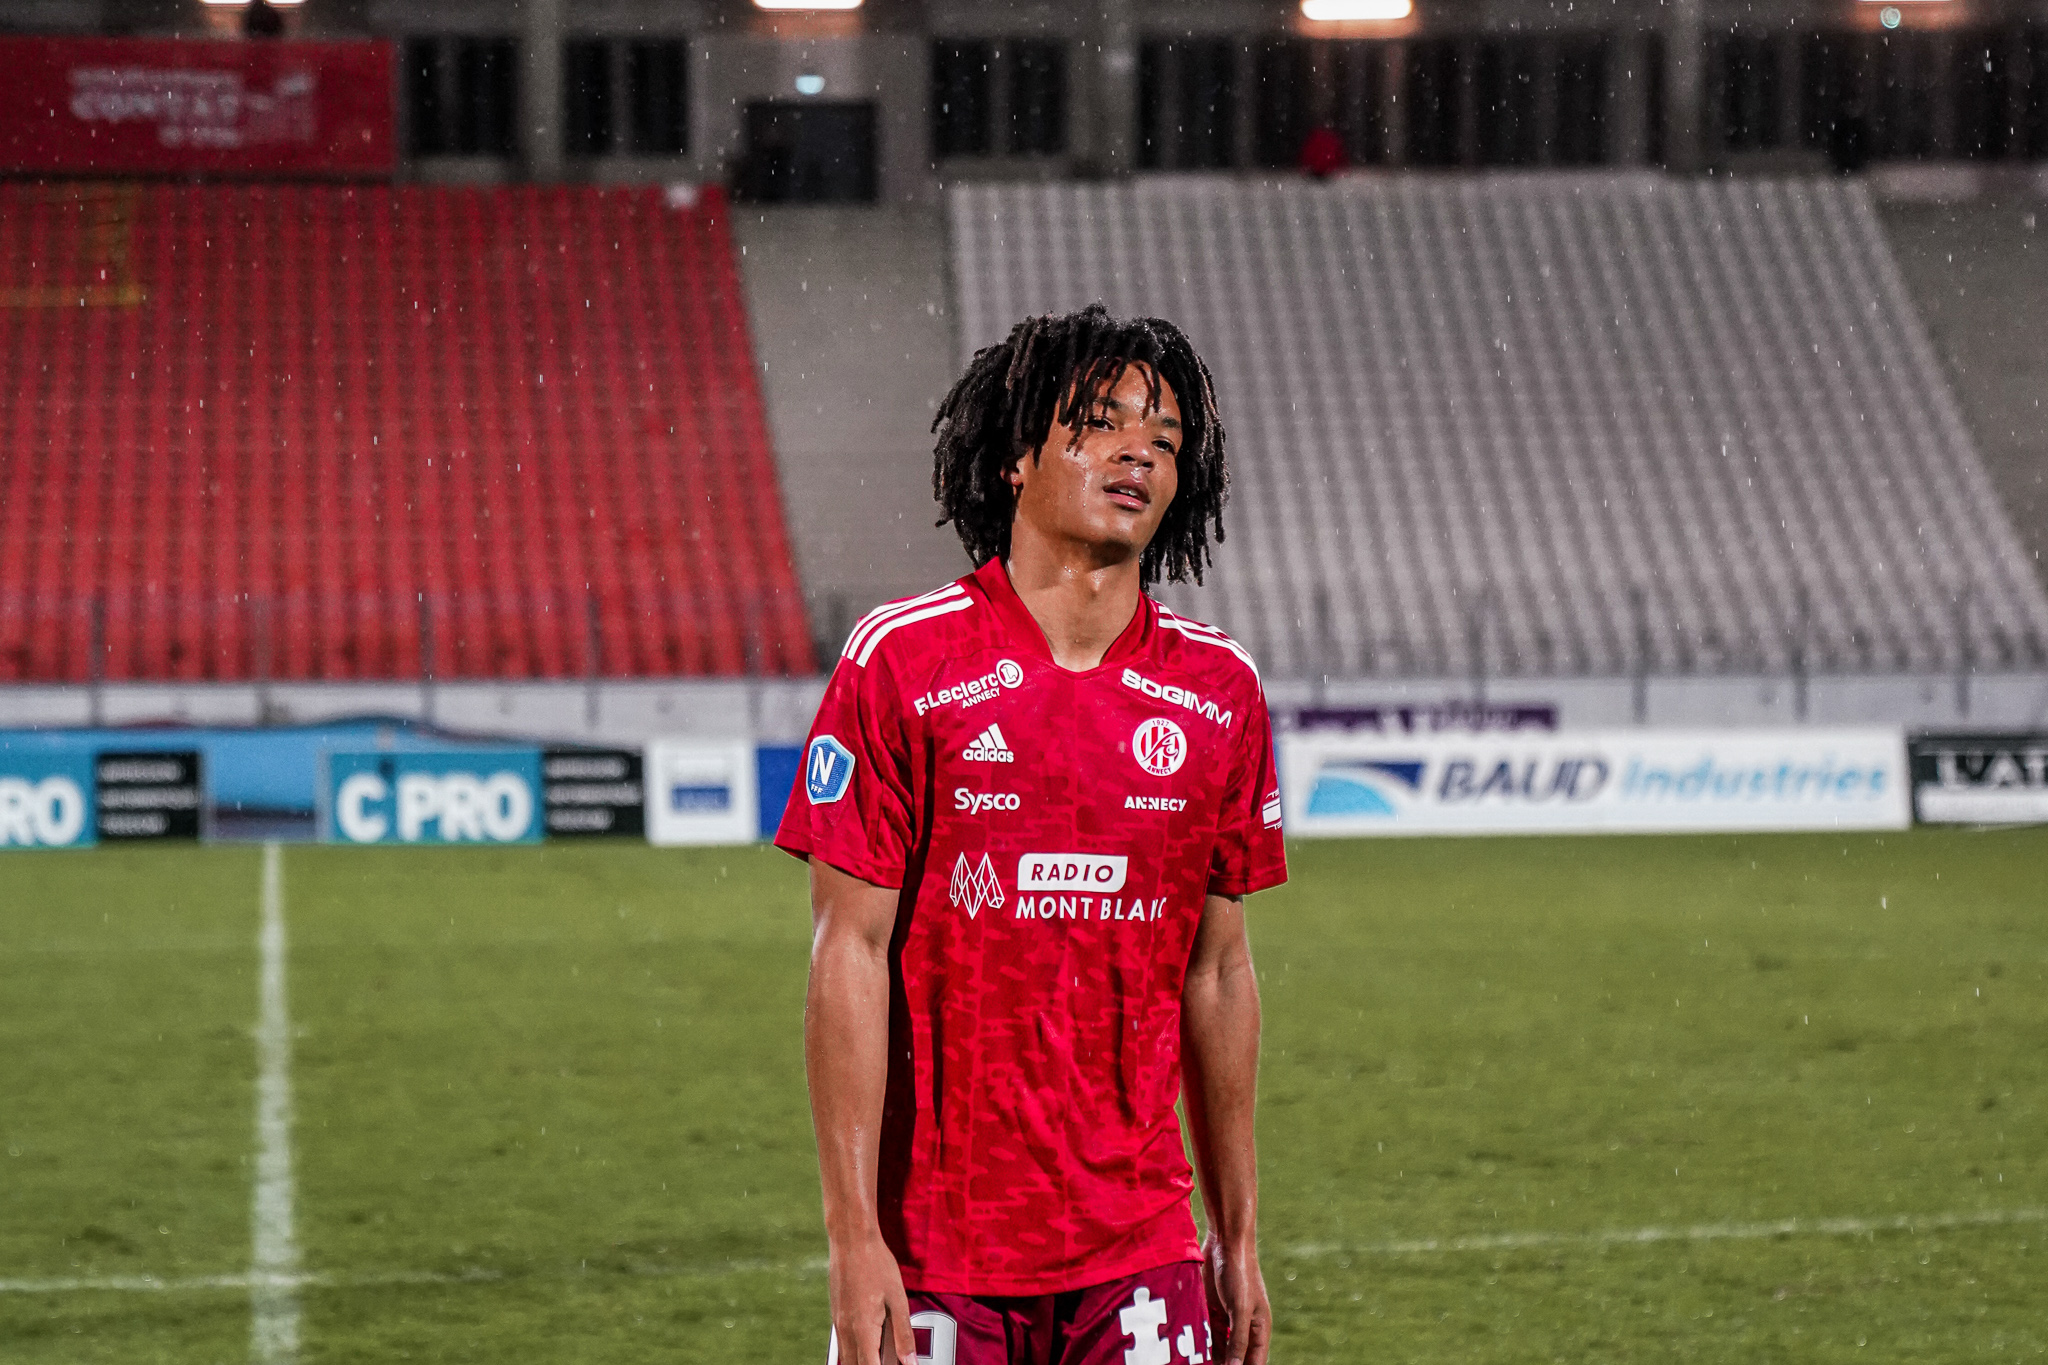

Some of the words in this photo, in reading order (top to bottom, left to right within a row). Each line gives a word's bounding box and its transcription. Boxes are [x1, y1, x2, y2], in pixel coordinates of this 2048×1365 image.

[962, 687, 1000, 709] ANNECY
[1121, 668, 1232, 729] SOGIMM
[1152, 719, 1170, 727] 1927
[811, 746, 836, 786] N
[962, 748, 1014, 763] adidas
[1146, 765, 1172, 775] ANNECY
[1437, 759, 1609, 804] BAUD
[1620, 757, 1890, 801] Industries
[811, 783, 823, 793] FFF
[400, 770, 534, 844] PRO
[954, 787, 1021, 815] Sysco
[1124, 796, 1187, 812] ANNECY
[1031, 863, 1114, 883] RADIO
[1015, 896, 1094, 920] MONT
